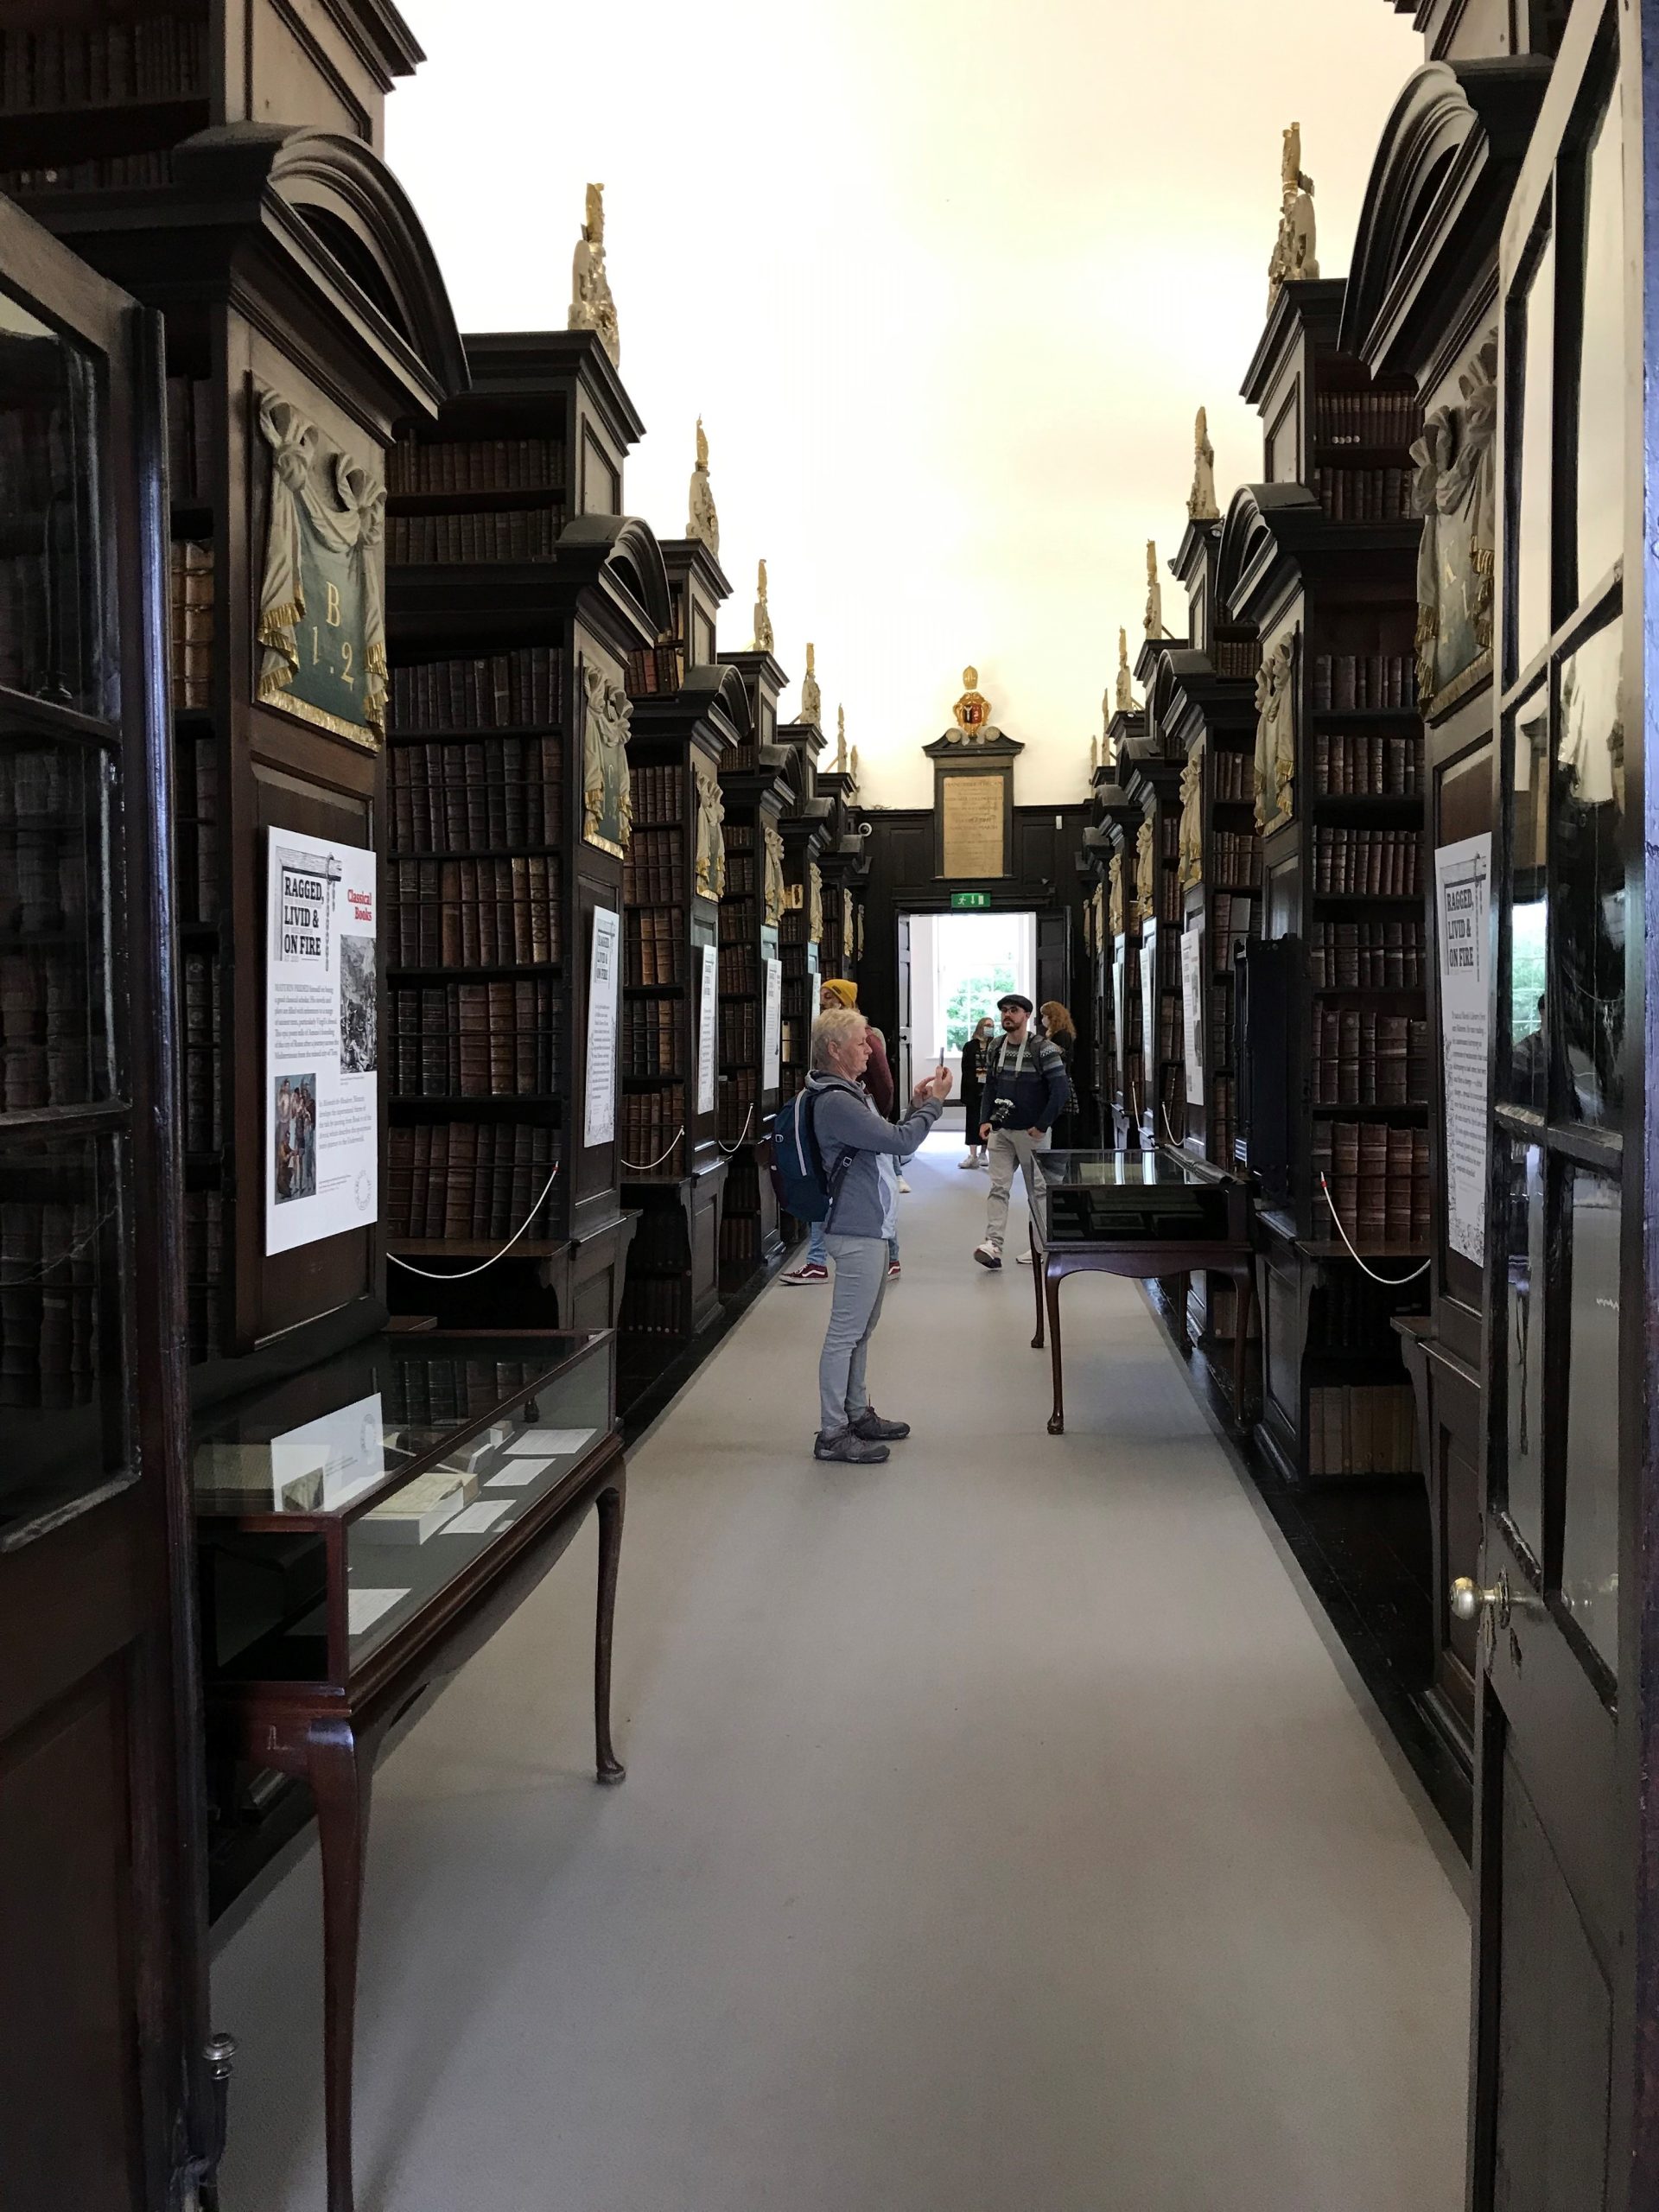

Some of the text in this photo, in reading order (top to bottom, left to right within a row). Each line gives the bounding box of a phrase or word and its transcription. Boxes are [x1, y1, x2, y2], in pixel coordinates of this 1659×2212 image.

[326, 581, 341, 626] B
[284, 876, 324, 905] RAGGED,
[347, 889, 372, 906] Classical
[1446, 888, 1474, 912] RAGGED,
[284, 905, 320, 928] LIVID &
[354, 906, 372, 921] Books
[1447, 918, 1471, 939] LIVID &
[284, 933, 321, 956] ON FIRE
[1449, 946, 1474, 967] ON FIRE
